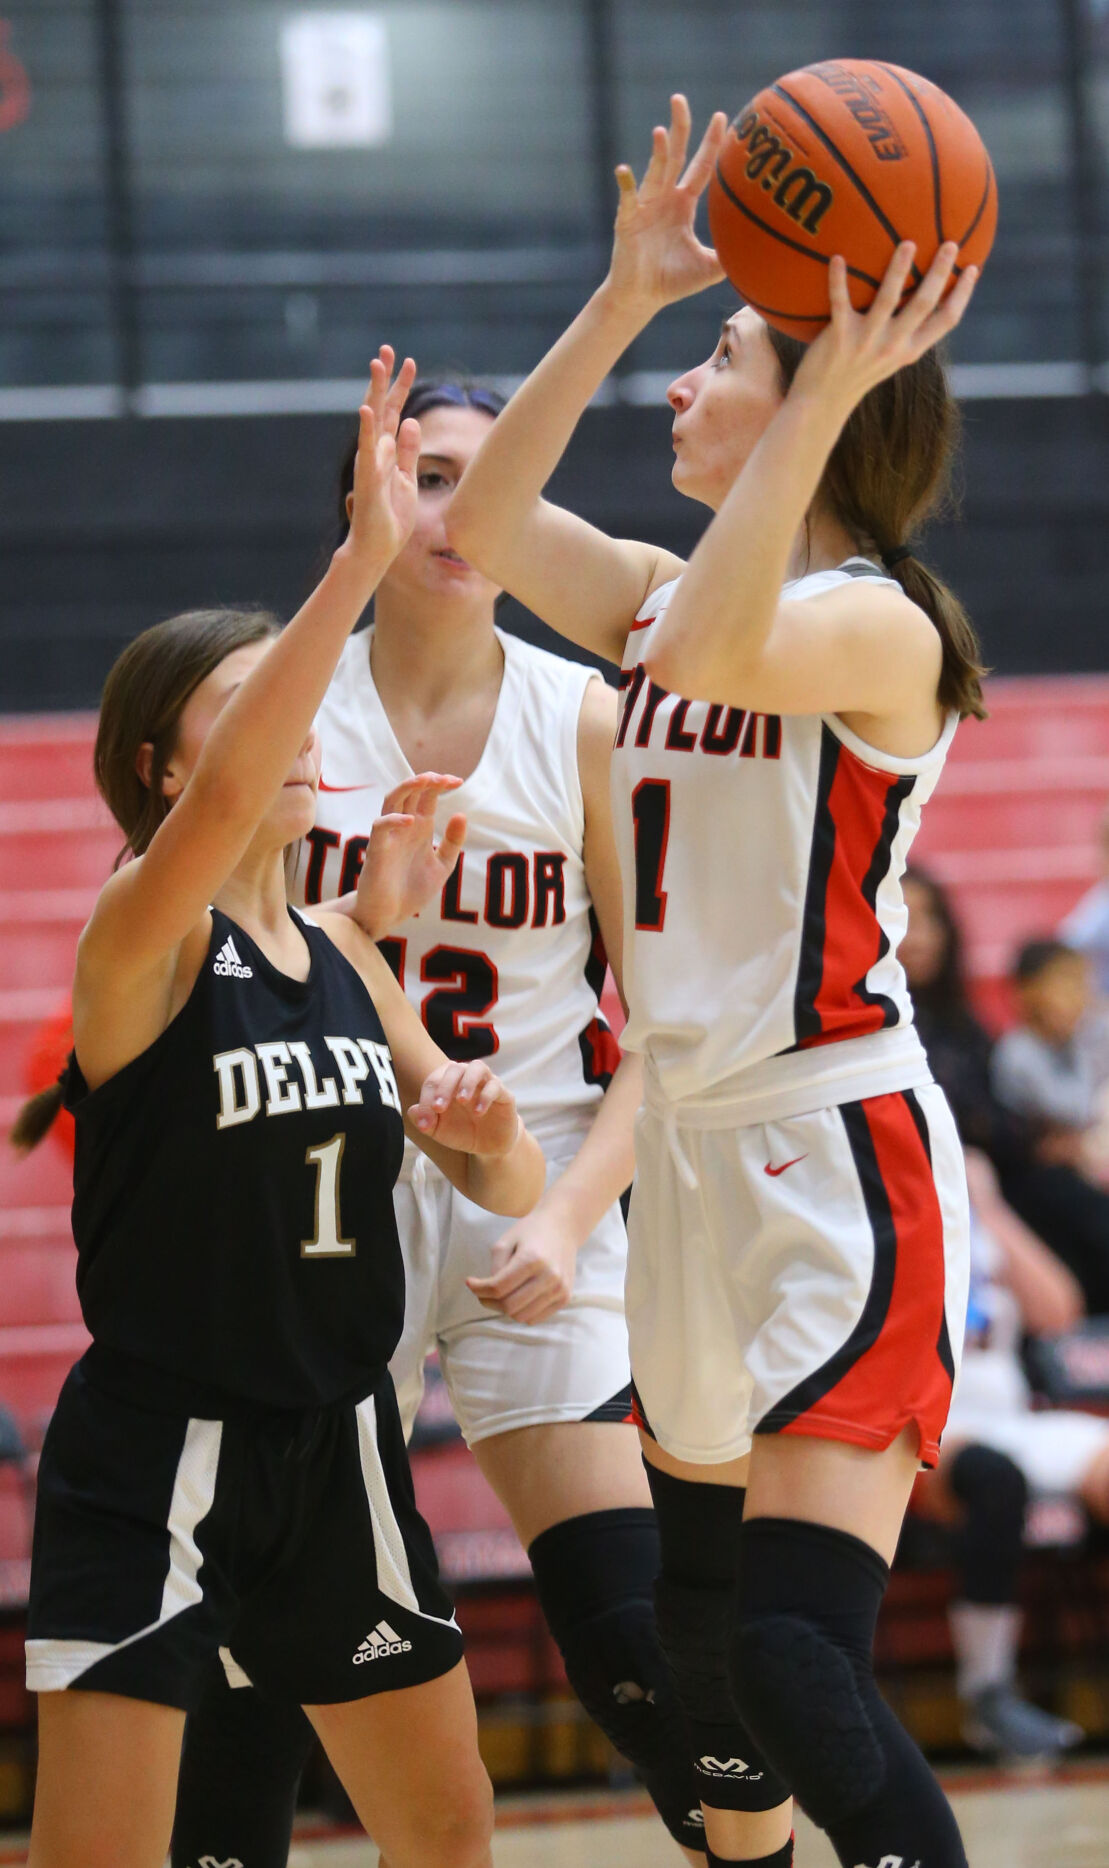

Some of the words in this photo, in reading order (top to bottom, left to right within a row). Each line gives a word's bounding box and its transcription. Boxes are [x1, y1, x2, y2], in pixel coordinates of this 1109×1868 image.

[808, 64, 901, 161] EVOLUT
[734, 110, 834, 236] Wilso
[304, 826, 568, 930] TALOR
[632, 777, 671, 932] 1
[213, 960, 253, 979] adidas
[301, 1133, 356, 1258] 1
[352, 1640, 413, 1665] adidas
